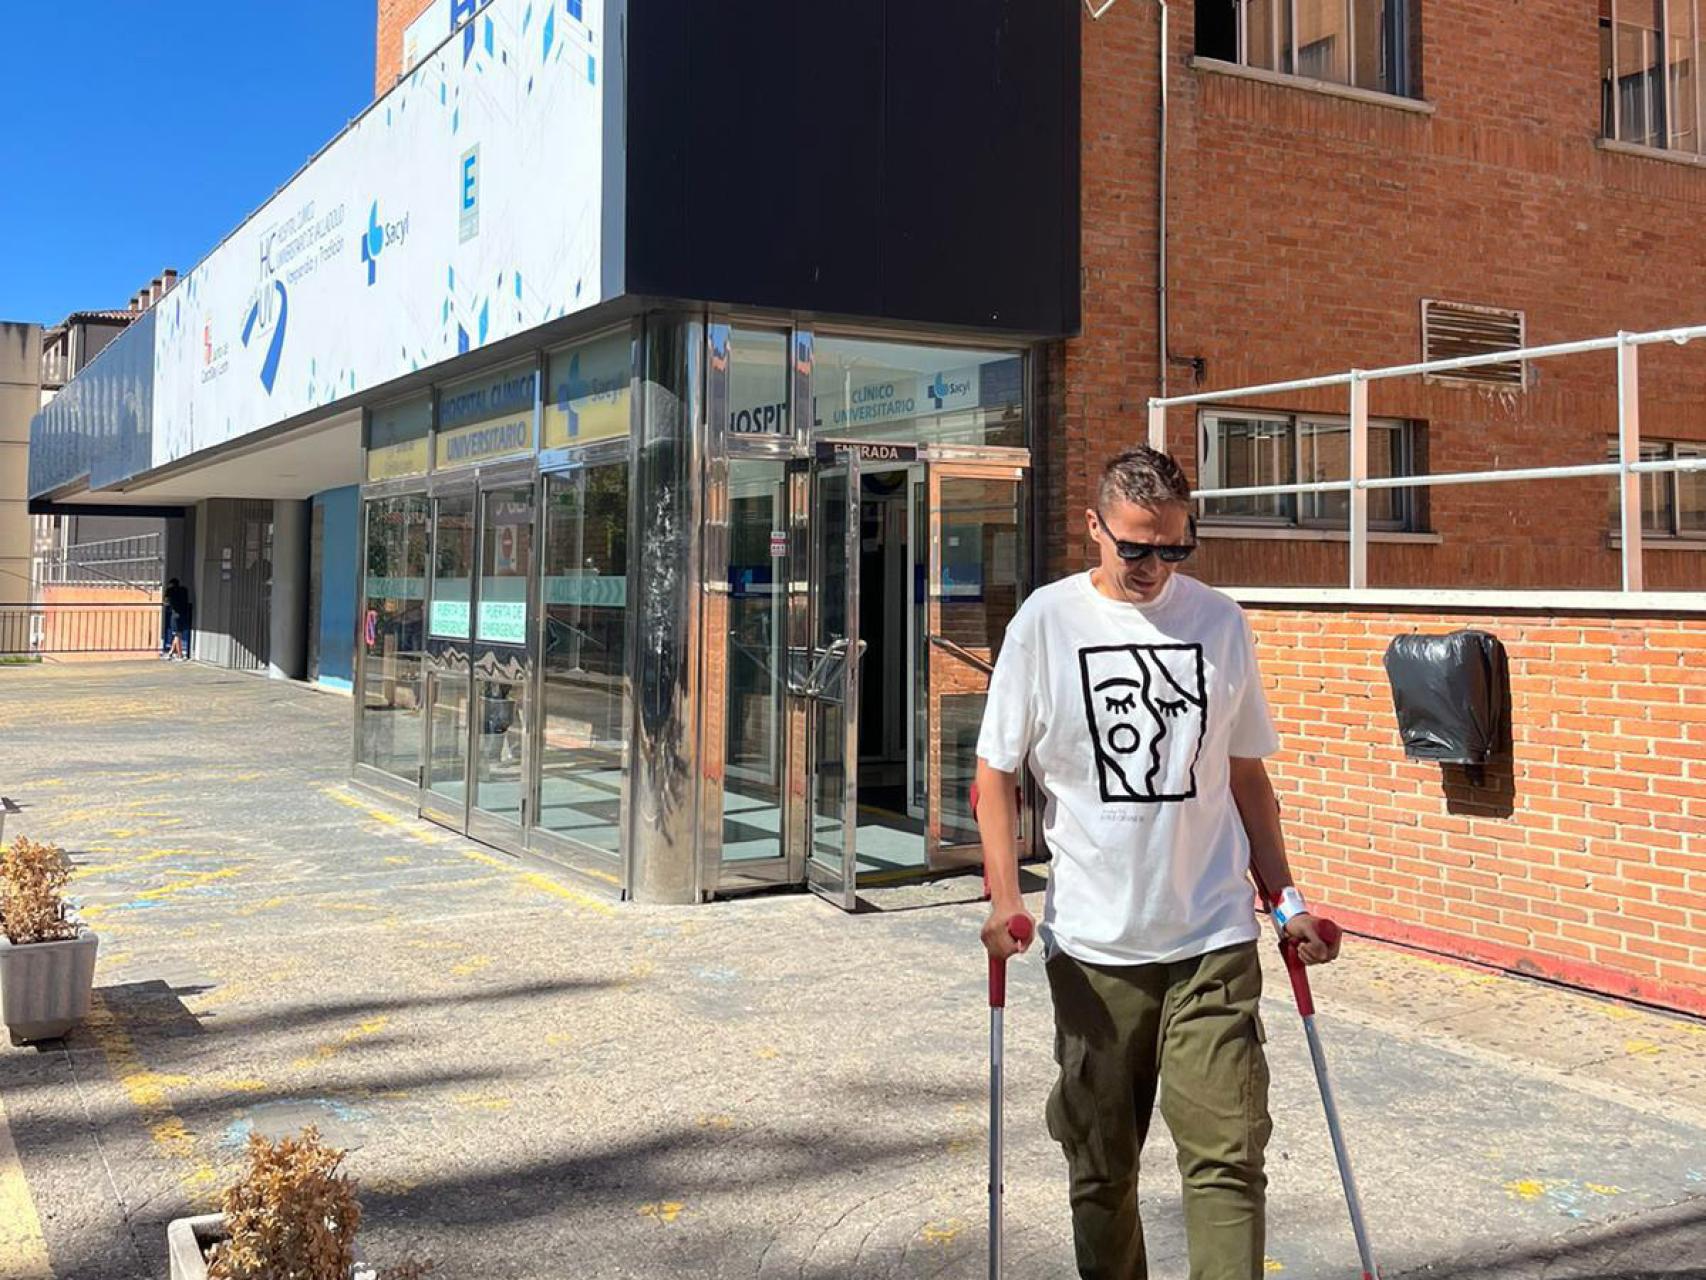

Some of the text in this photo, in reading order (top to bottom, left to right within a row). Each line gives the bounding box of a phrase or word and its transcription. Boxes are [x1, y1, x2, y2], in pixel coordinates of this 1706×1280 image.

[464, 155, 476, 210] E
[385, 210, 410, 247] Sacyl
[440, 388, 488, 424] HOSPITAL
[949, 380, 971, 396] Sacyl
[832, 398, 916, 424] UNIVERSITARIO
[446, 420, 528, 460] UNIVERSITARIO
